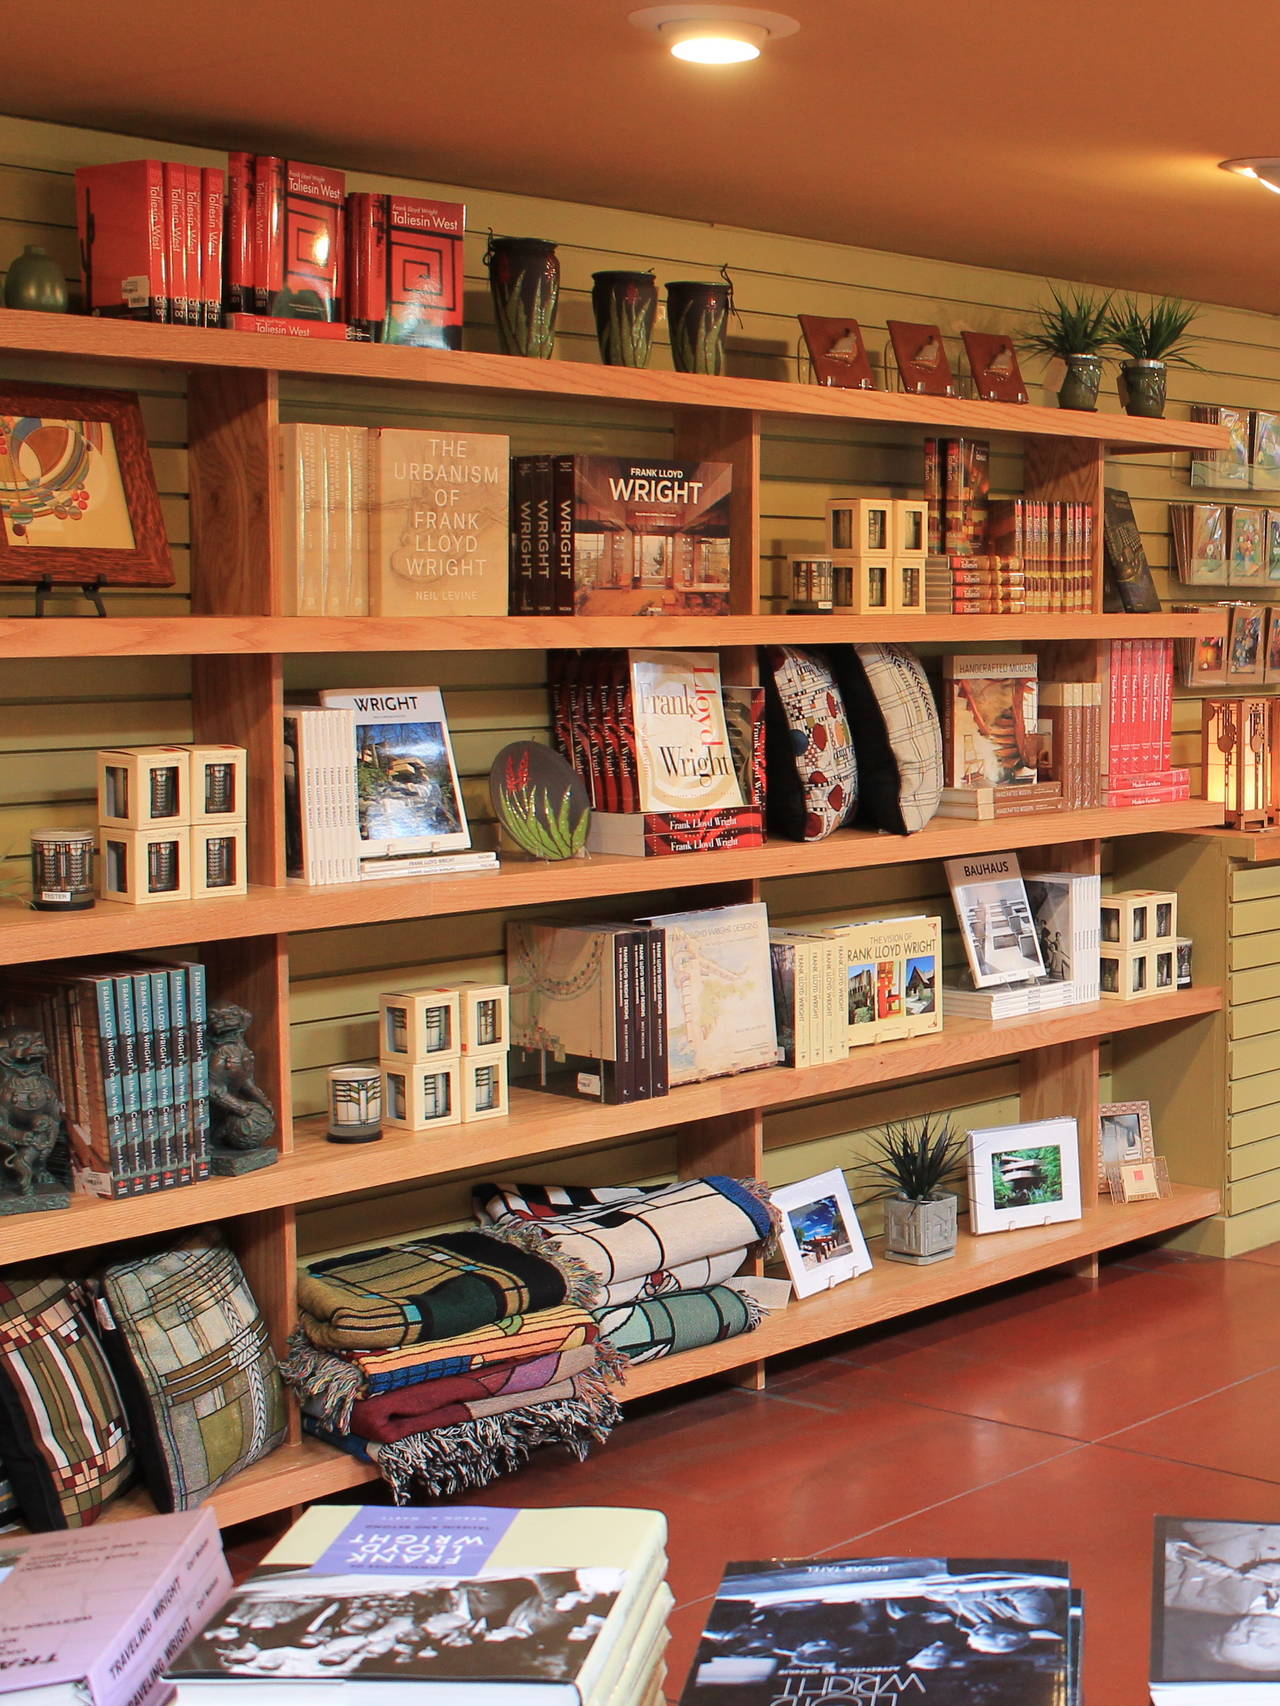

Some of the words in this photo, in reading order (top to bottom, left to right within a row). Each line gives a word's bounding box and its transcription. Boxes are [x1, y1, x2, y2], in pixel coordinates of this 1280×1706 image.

[288, 178, 320, 195] Taliesin
[320, 184, 340, 199] West
[392, 212, 430, 228] Taliesin
[432, 217, 458, 231] West
[256, 322, 286, 335] Taliesin
[290, 325, 310, 337] West
[429, 438, 467, 458] THE
[394, 463, 499, 484] URBANISM
[631, 468, 657, 477] FRANK
[658, 469, 683, 478] LLOYD
[434, 488, 460, 507] OF
[608, 478, 704, 504] WRIGHT
[415, 511, 480, 530] FRANK
[416, 535, 478, 552] LLOYD
[520, 501, 532, 579] WRIGHT
[537, 500, 549, 579] WRIGHT
[560, 500, 571, 579] WRIGHT
[406, 558, 487, 577] WRIGHT
[354, 696, 419, 712] WRIGHT
[640, 682, 696, 716] Frank
[692, 667, 724, 746] Lloyd
[658, 746, 732, 788] Wright
[670, 820, 691, 831] Frank
[692, 818, 713, 830] Lloyd
[714, 816, 737, 828] Wright
[670, 842, 692, 852] Frank
[694, 840, 714, 852] Lloyd
[715, 838, 739, 850] Wright
[964, 861, 1009, 877] BAUHAUS
[847, 950, 872, 962] RANK
[874, 944, 901, 958] LLOYD
[903, 938, 936, 955] WRIGHT
[102, 986, 111, 1012] FRANK
[140, 981, 148, 1008] FRANK
[156, 979, 164, 1004] FRANK
[176, 1002, 184, 1028] LLOYD
[194, 998, 202, 1024] LLOYD
[104, 1013, 112, 1039] LLOYD
[122, 983, 130, 1010] FRANK
[126, 1036, 134, 1068] WRIGHT
[143, 1034, 152, 1066] WRIGHT
[159, 1032, 167, 1064] WRIGHT
[177, 1029, 185, 1060] WRIGHT
[196, 1024, 204, 1055] WRIGHT
[106, 1040, 116, 1070] WRIGHT
[349, 1533, 485, 1546] WRIGHT
[359, 1543, 464, 1554] LLOYD
[346, 1552, 462, 1565] FRANK
[845, 1565, 889, 1573] EDGAR
[109, 1616, 152, 1680] TRAVELING
[152, 1576, 182, 1620] WRIGHT
[165, 1616, 193, 1657] WRIGHT
[772, 1672, 926, 1697] WRIGHT
